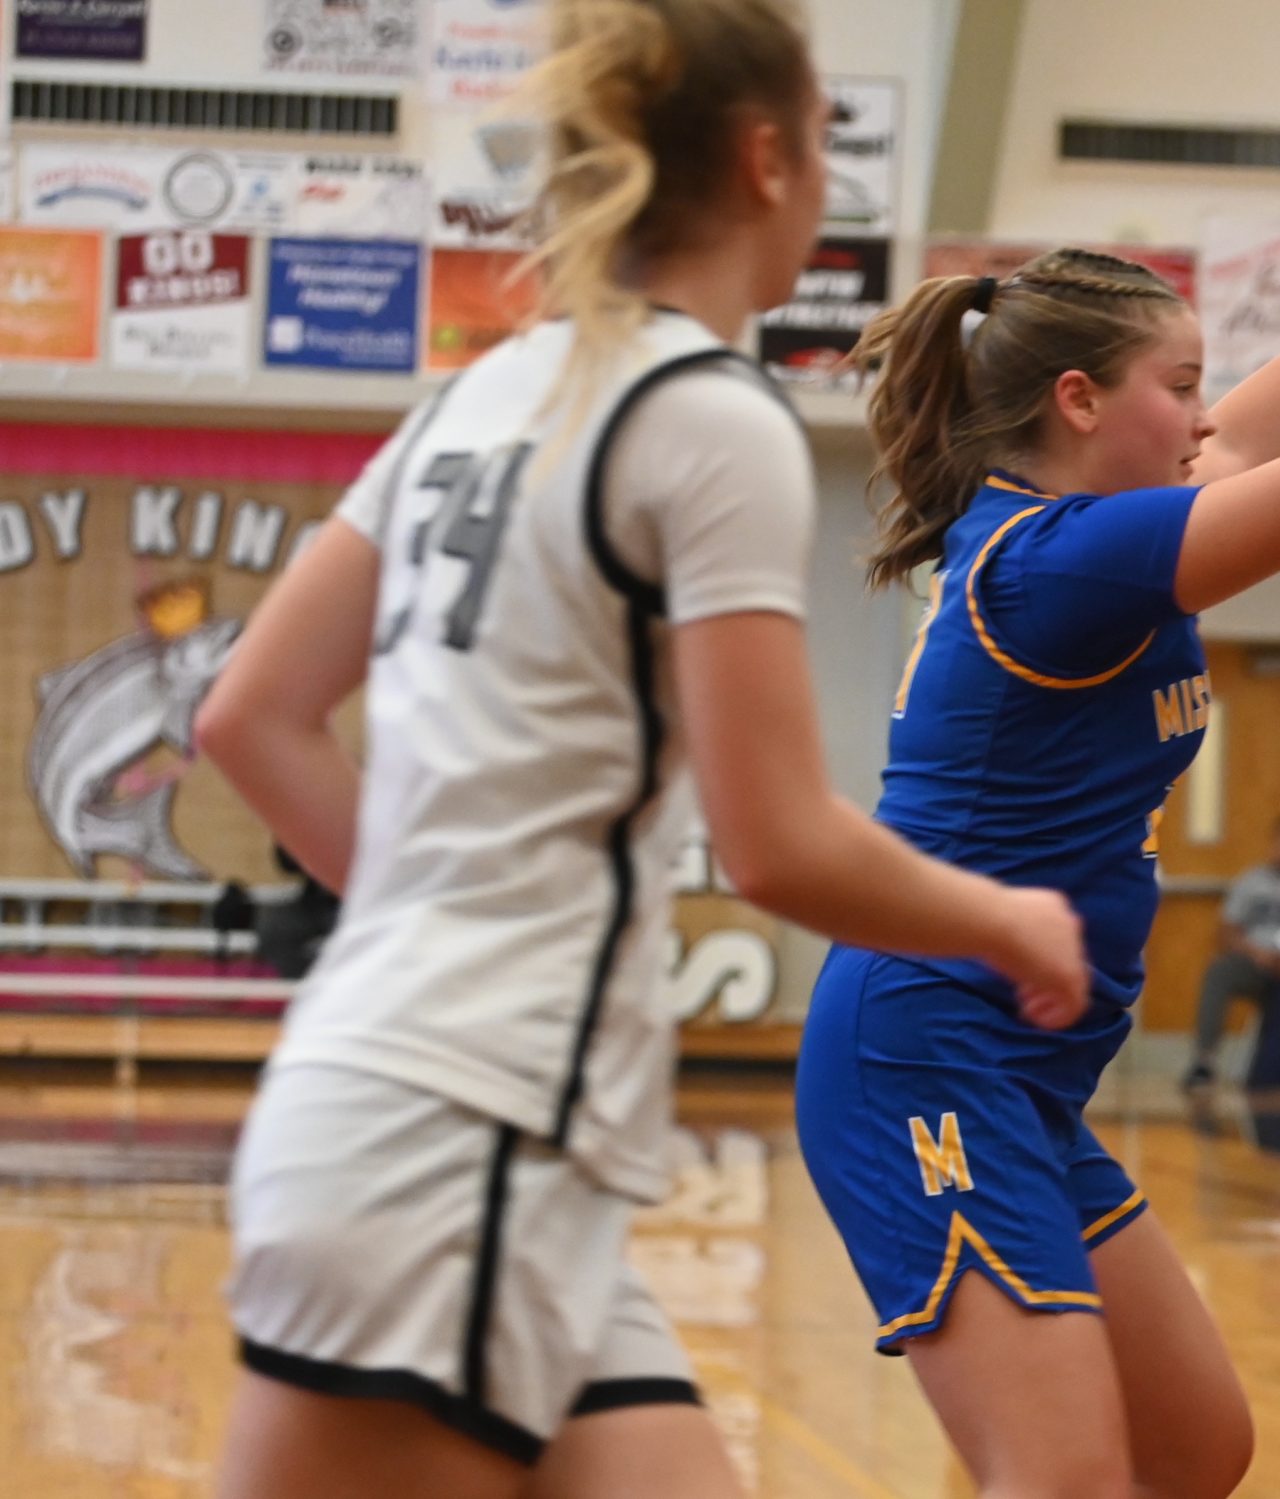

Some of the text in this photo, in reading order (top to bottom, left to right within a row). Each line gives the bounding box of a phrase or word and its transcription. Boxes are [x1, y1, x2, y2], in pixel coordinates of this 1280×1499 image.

[132, 487, 330, 571] KIN
[1152, 670, 1212, 742] MIS
[908, 1111, 976, 1197] M
